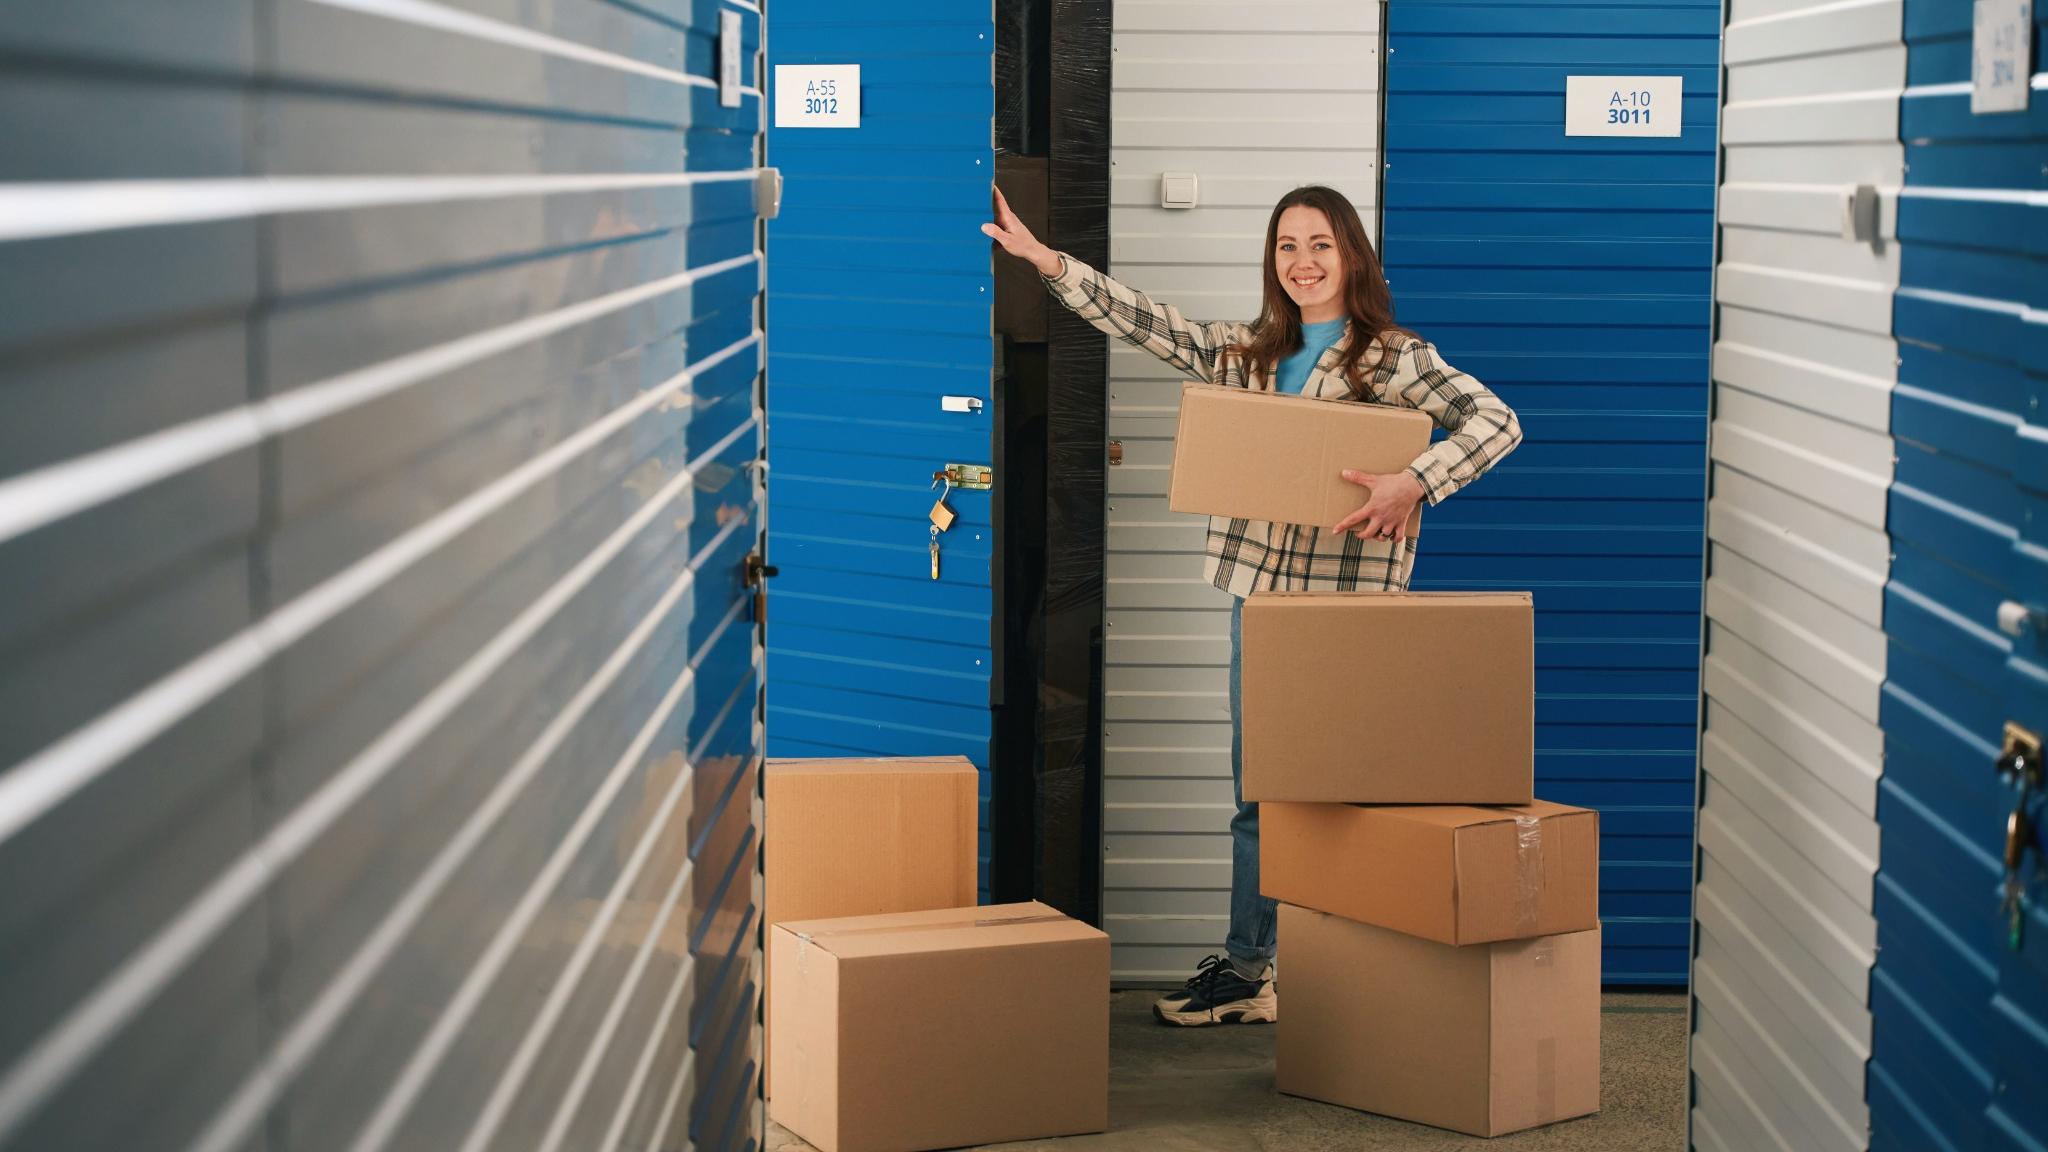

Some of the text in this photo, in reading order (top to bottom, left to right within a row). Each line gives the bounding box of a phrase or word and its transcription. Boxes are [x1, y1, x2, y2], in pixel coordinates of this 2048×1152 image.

[806, 80, 836, 95] A-55
[805, 99, 837, 113] 3012
[1610, 91, 1651, 106] A-10
[1608, 109, 1650, 124] 3011
